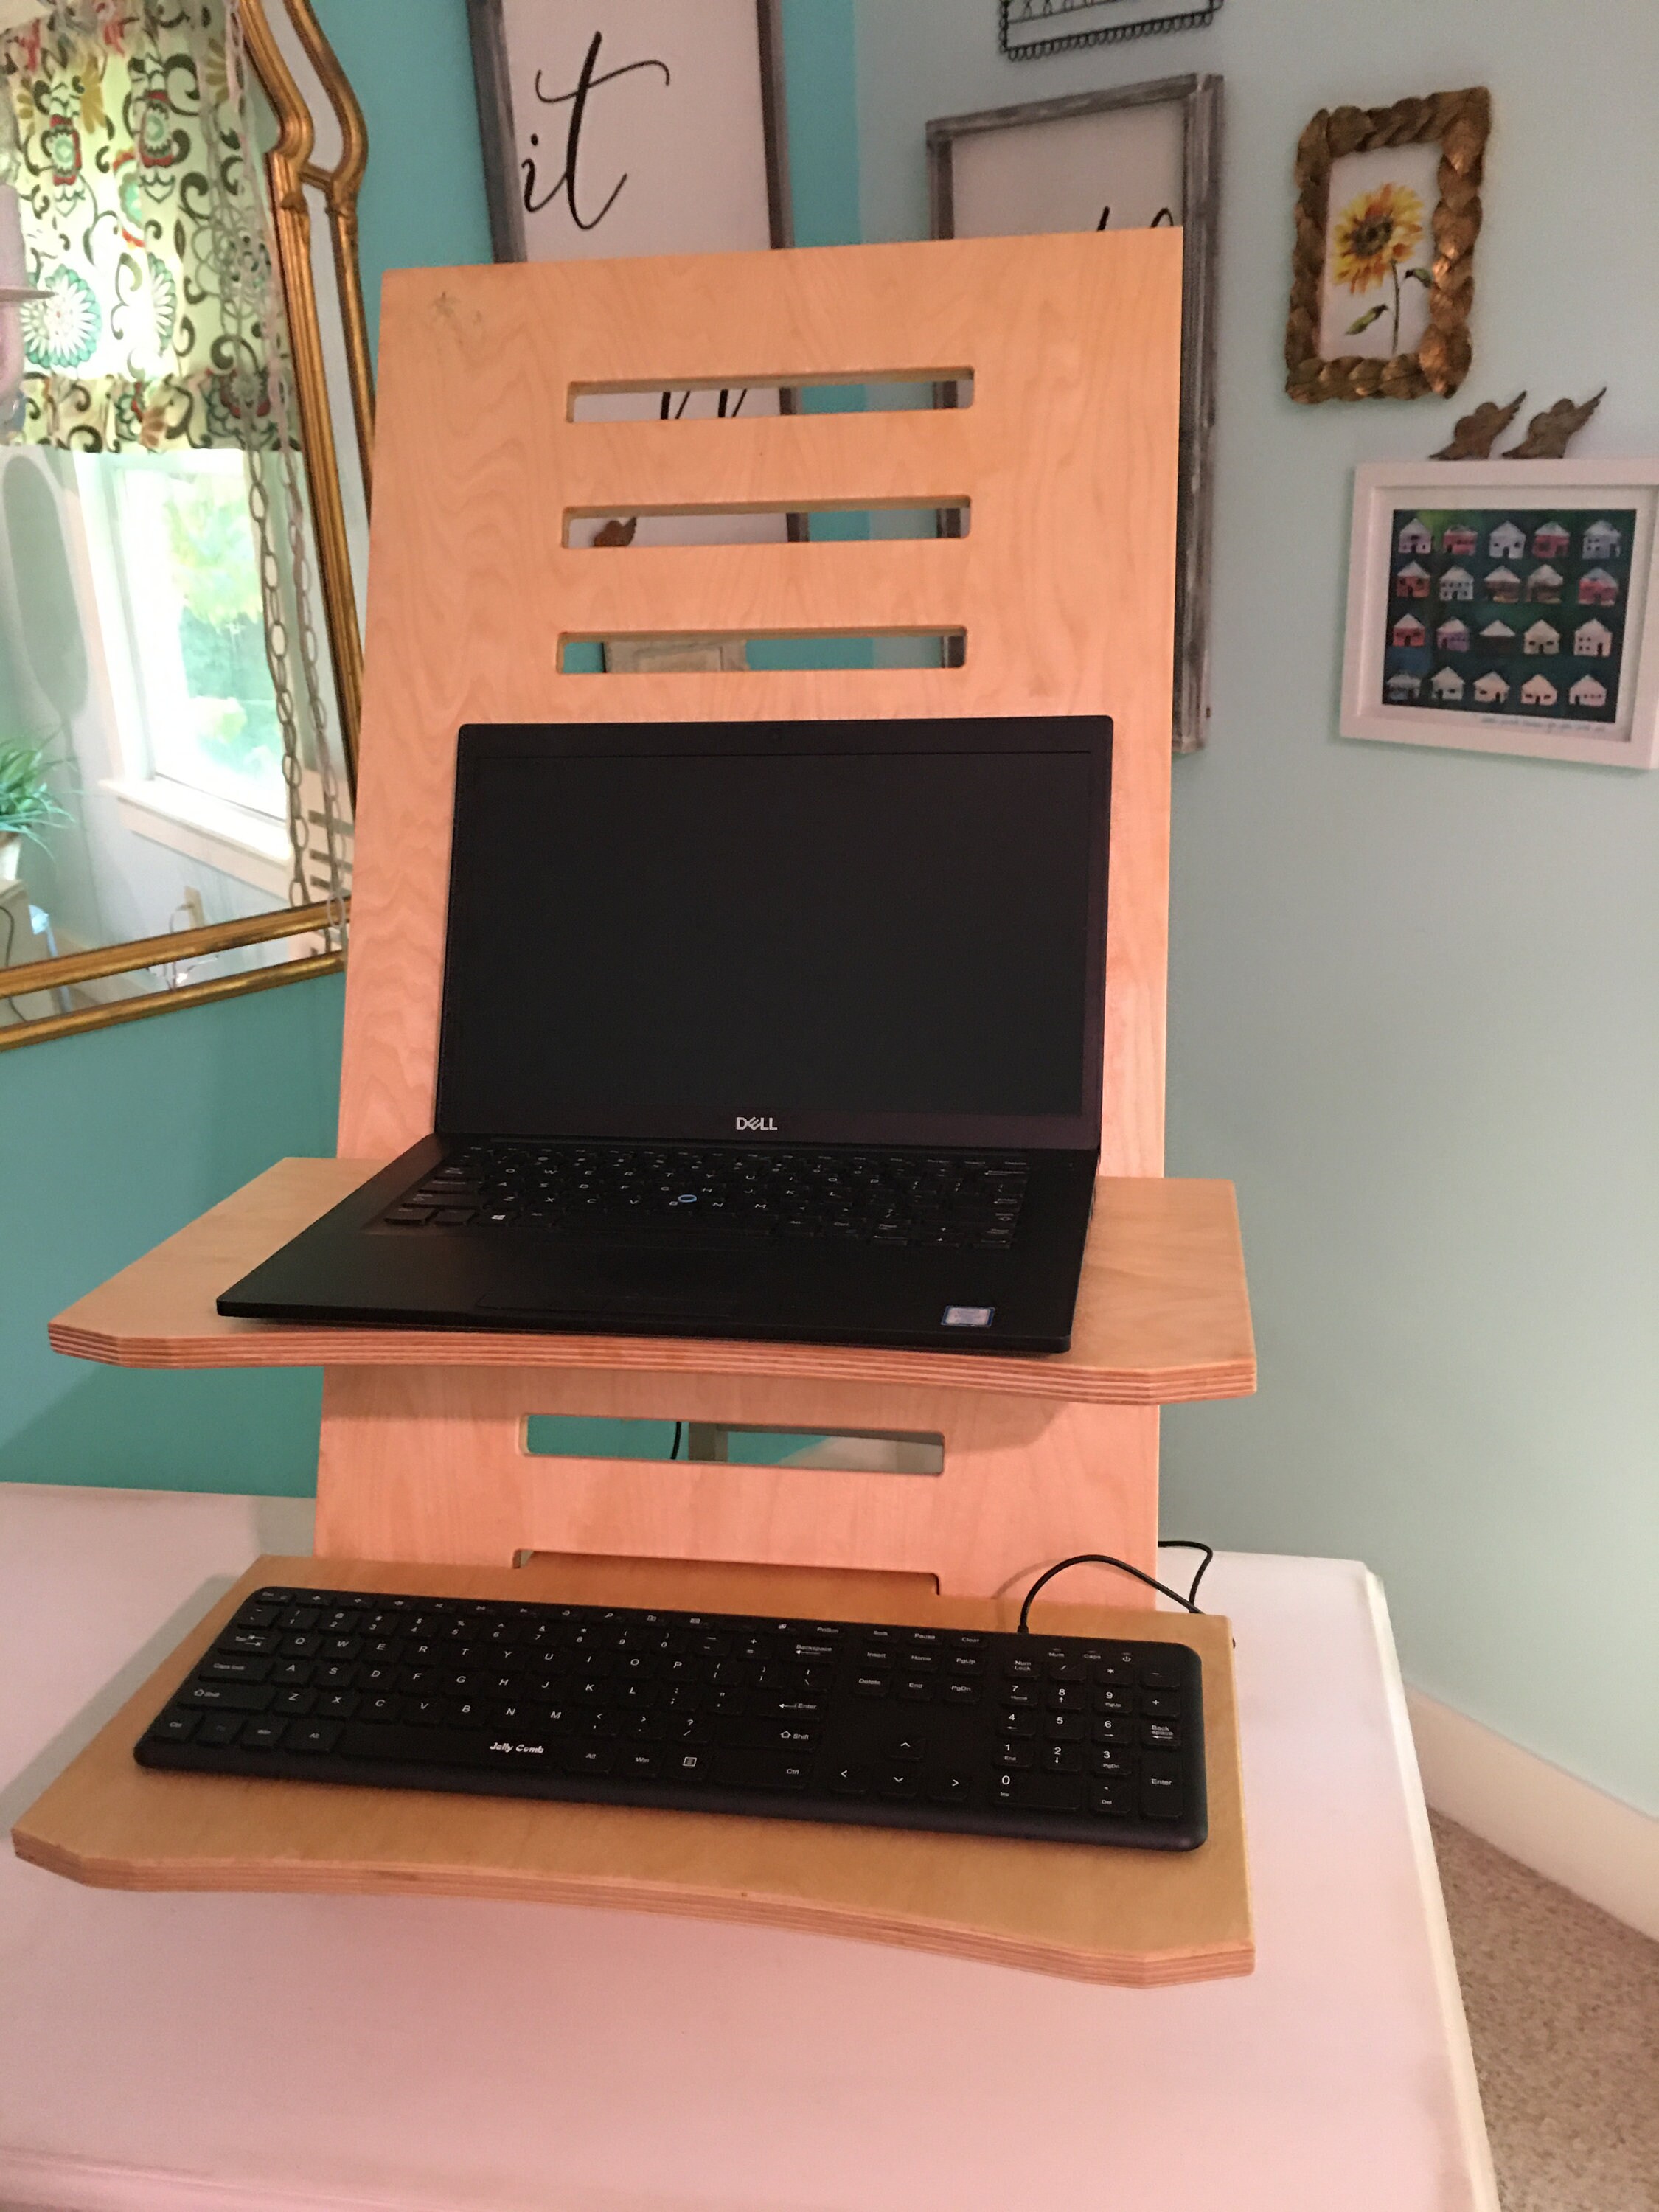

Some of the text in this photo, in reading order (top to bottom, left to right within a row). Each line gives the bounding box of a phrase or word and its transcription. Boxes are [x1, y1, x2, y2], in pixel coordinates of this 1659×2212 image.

[521, 30, 670, 230] it
[736, 1116, 778, 1130] DELL
[294, 1637, 305, 1645] Q
[337, 1640, 349, 1648] W
[376, 1643, 386, 1651] E
[796, 1644, 832, 1652] Backspace
[630, 1658, 640, 1666] O
[328, 1667, 338, 1675] S
[370, 1669, 381, 1677] D
[456, 1675, 467, 1683] G
[585, 1683, 594, 1691] K
[629, 1686, 636, 1694] L
[288, 1693, 299, 1701] Z
[332, 1696, 341, 1704] X
[375, 1699, 386, 1707] C
[420, 1702, 429, 1710] V
[462, 1705, 471, 1713] B
[505, 1708, 516, 1716] N
[550, 1711, 562, 1719] M
[1056, 1717, 1064, 1725] 5
[1104, 1720, 1112, 1728] 6
[489, 1742, 544, 1754] Jelly Comb
[1005, 1743, 1010, 1751] 1
[1054, 1747, 1062, 1756] 2
[1103, 1750, 1111, 1759] 3
[1001, 1775, 1011, 1785] 0
[1151, 1778, 1172, 1786] Enter
